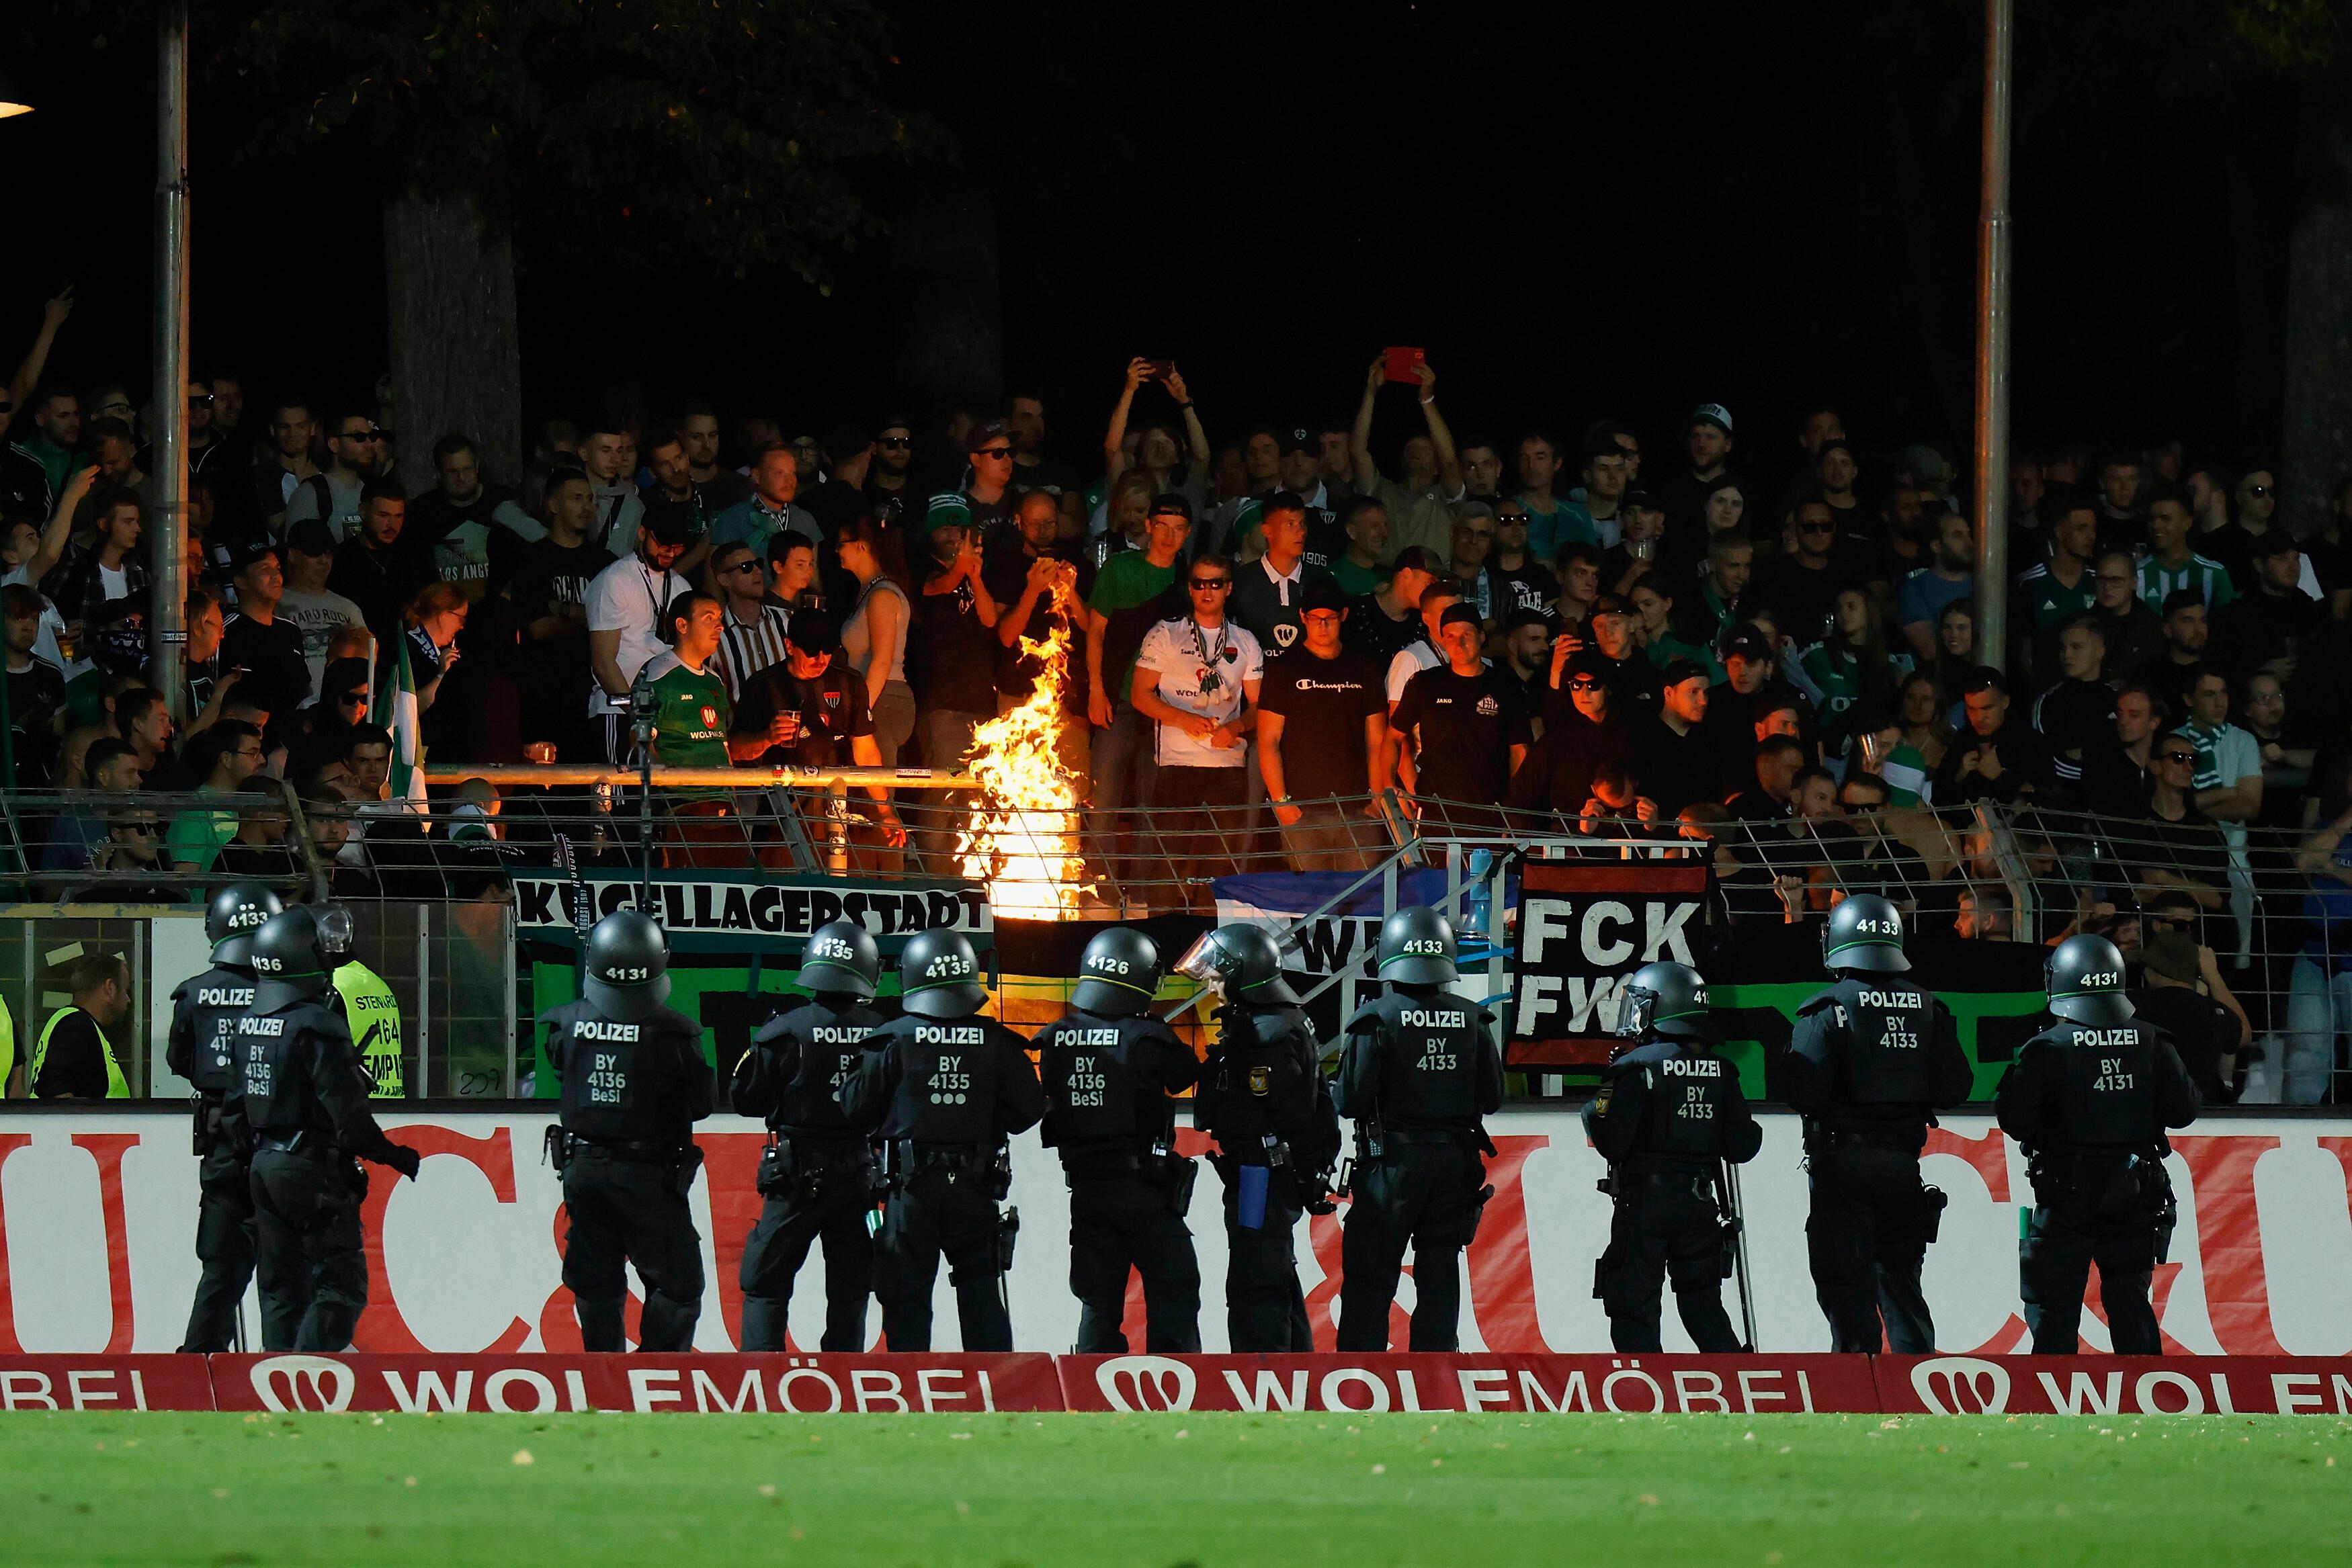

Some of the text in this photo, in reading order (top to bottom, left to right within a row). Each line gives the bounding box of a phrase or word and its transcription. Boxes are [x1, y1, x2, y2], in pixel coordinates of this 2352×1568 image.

[1296, 679, 1363, 693] Champion
[228, 912, 268, 928] 4133
[1522, 898, 1700, 967] FCK
[812, 943, 853, 960] 4135
[1403, 939, 1443, 954] 4133
[1087, 955, 1129, 975] 4126
[606, 967, 647, 980] 4131
[2081, 971, 2117, 986] 4131
[198, 988, 255, 1006] POLIZE
[1516, 973, 1635, 1036] FW
[1859, 992, 1922, 1008] POLIZEI
[239, 1018, 284, 1036] POLIZEI
[1400, 1010, 1466, 1029] POLIZEI
[1886, 1016, 1905, 1031] BY
[574, 1021, 639, 1042] POLIZEI
[915, 1027, 984, 1045] POLIZEI
[1054, 1029, 1120, 1047] POLIZEI
[2072, 1029, 2139, 1047] POLIZEI
[1427, 1038, 1447, 1054] BY
[1880, 1033, 1918, 1049] 4133
[249, 1045, 265, 1061] BY
[595, 1054, 617, 1071] BY
[939, 1056, 961, 1073] BY
[1075, 1057, 1096, 1073] BY
[1417, 1055, 1457, 1071] 4133
[1663, 1059, 1720, 1077] POLIZEI
[2101, 1058, 2122, 1075] BY
[245, 1063, 271, 1080] 4136
[247, 1079, 269, 1096] BeSi
[588, 1074, 626, 1089] 4136
[927, 1074, 970, 1090] 4135
[1067, 1074, 1105, 1090] 4136
[2093, 1075, 2134, 1092] 4131
[591, 1088, 620, 1103] BeSi
[1071, 1091, 1103, 1106] BeSi
[1687, 1086, 1706, 1102] BY
[1677, 1103, 1714, 1119] 4133
